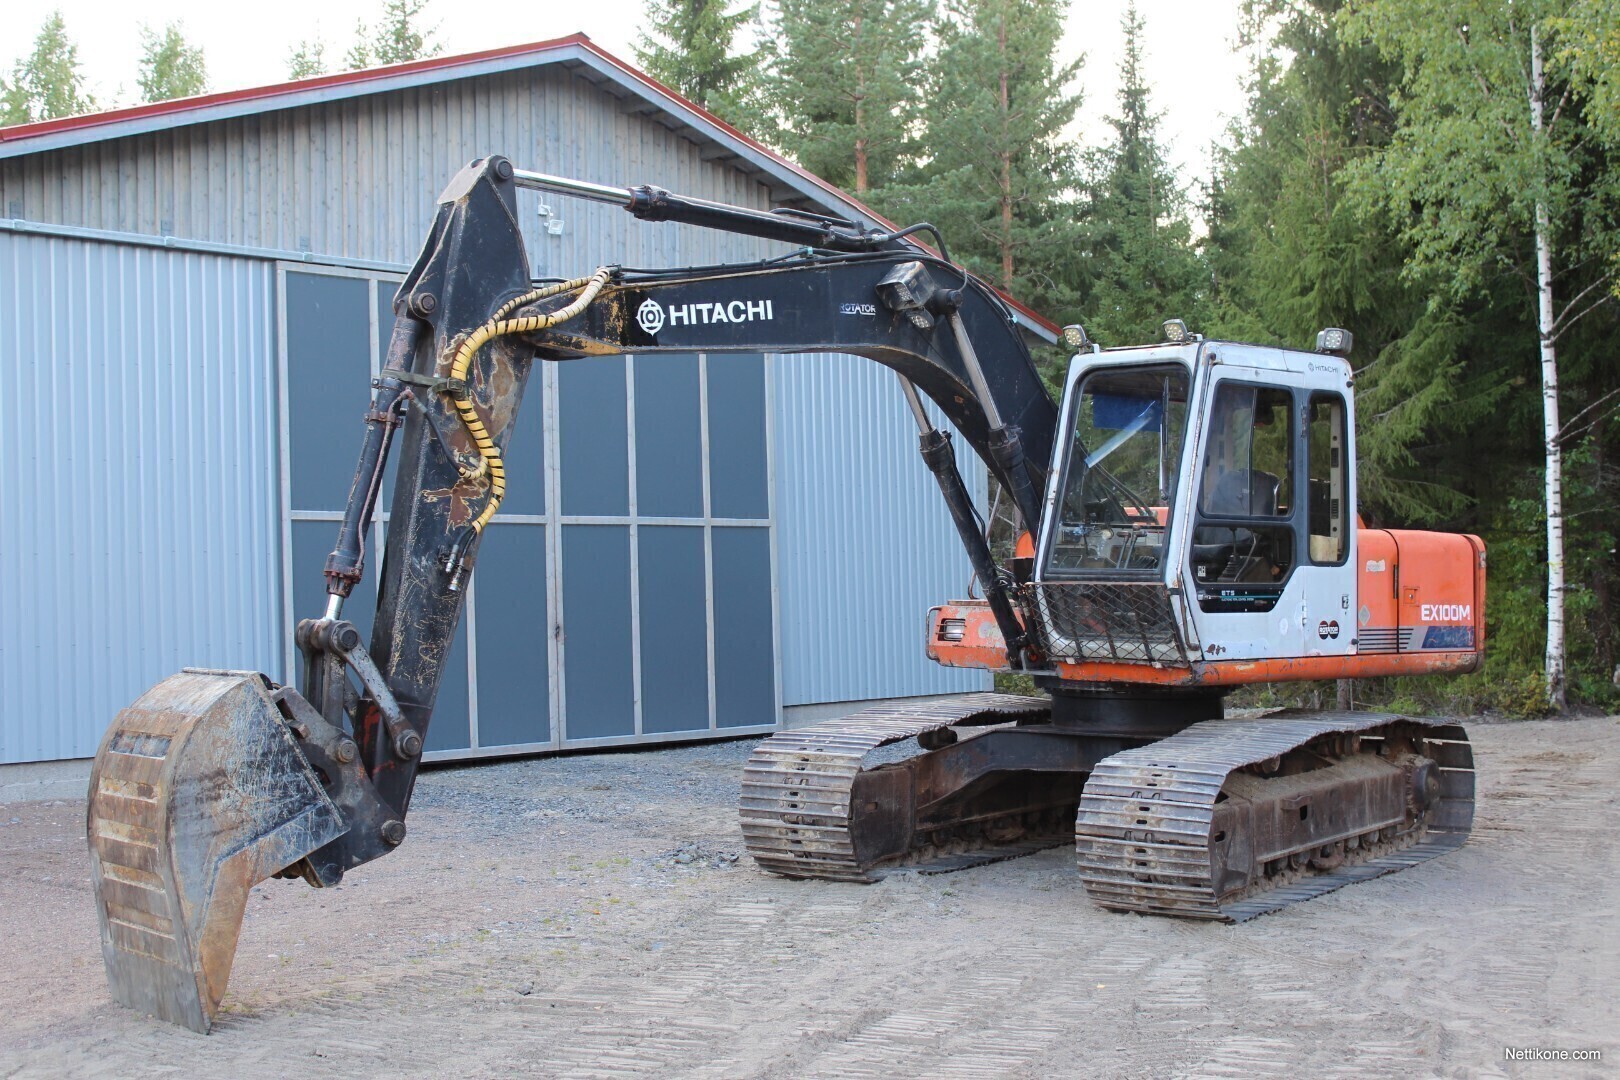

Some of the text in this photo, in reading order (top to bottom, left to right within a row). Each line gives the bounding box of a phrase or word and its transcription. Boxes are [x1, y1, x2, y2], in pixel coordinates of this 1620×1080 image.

[669, 299, 773, 326] HITACHI
[839, 303, 876, 313] ROTATOR
[1315, 365, 1339, 374] HITACHI
[1421, 604, 1471, 621] EX100M
